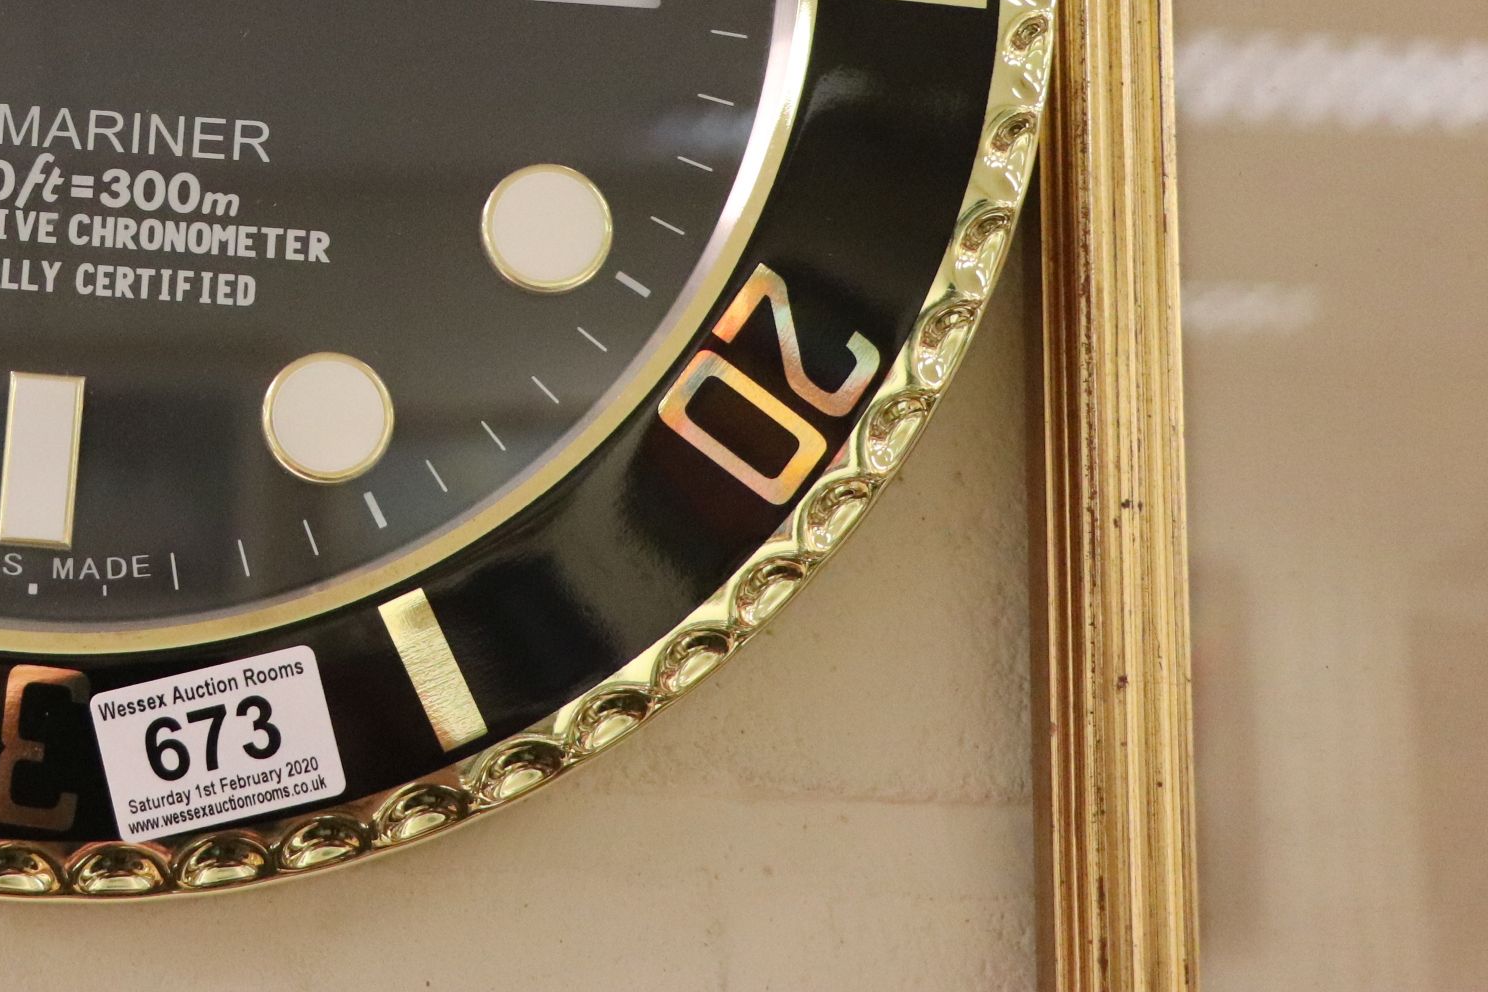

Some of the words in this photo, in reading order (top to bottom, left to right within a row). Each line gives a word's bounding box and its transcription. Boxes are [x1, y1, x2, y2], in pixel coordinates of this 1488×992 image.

[68, 214, 331, 263] CHRONOMETER
[75, 262, 256, 306] CERTIFIED
[658, 263, 880, 505] 20
[52, 554, 151, 580] MADE
[98, 692, 165, 721] Wessex
[172, 675, 239, 705] Auction
[243, 661, 304, 688] Rooms
[145, 695, 281, 781] 673
[128, 790, 191, 814] Saturday
[195, 782, 216, 799] 1st
[221, 767, 282, 793] February
[286, 756, 319, 777] 2020
[128, 774, 327, 834] www.wessexauctionrooms.co.uk
